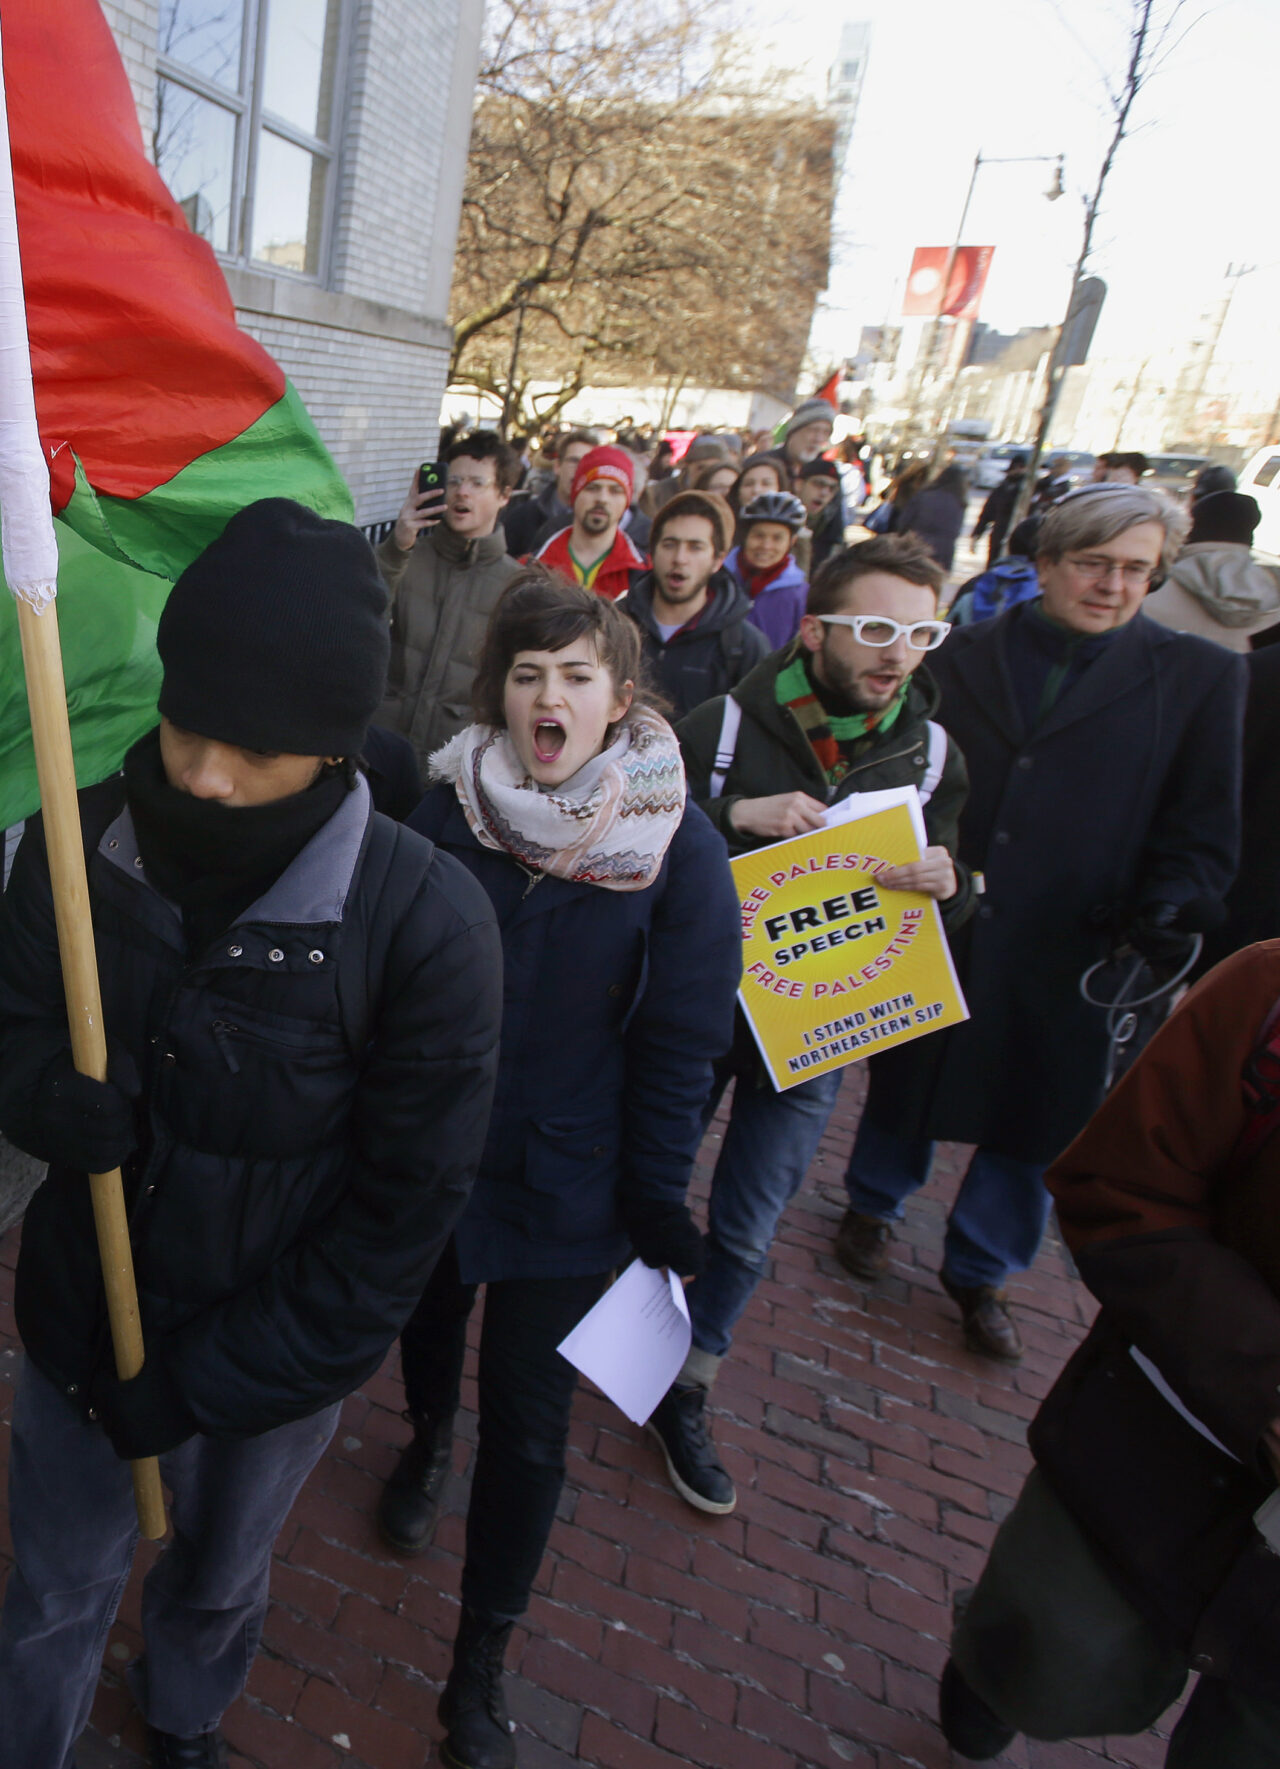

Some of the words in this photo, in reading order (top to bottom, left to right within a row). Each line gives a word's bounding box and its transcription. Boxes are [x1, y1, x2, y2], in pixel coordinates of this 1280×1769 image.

[771, 855, 896, 885] PALESTI
[765, 887, 878, 941] FREE
[748, 963, 803, 997] FREE
[815, 909, 922, 997] PALESTINE
[774, 916, 887, 966] SPEECH
[788, 1014, 912, 1072] NORTHEASTERN
[914, 1002, 944, 1024] SJP
[803, 1032, 812, 1046] I
[813, 1012, 867, 1042] STAND
[869, 994, 915, 1020] WITH
